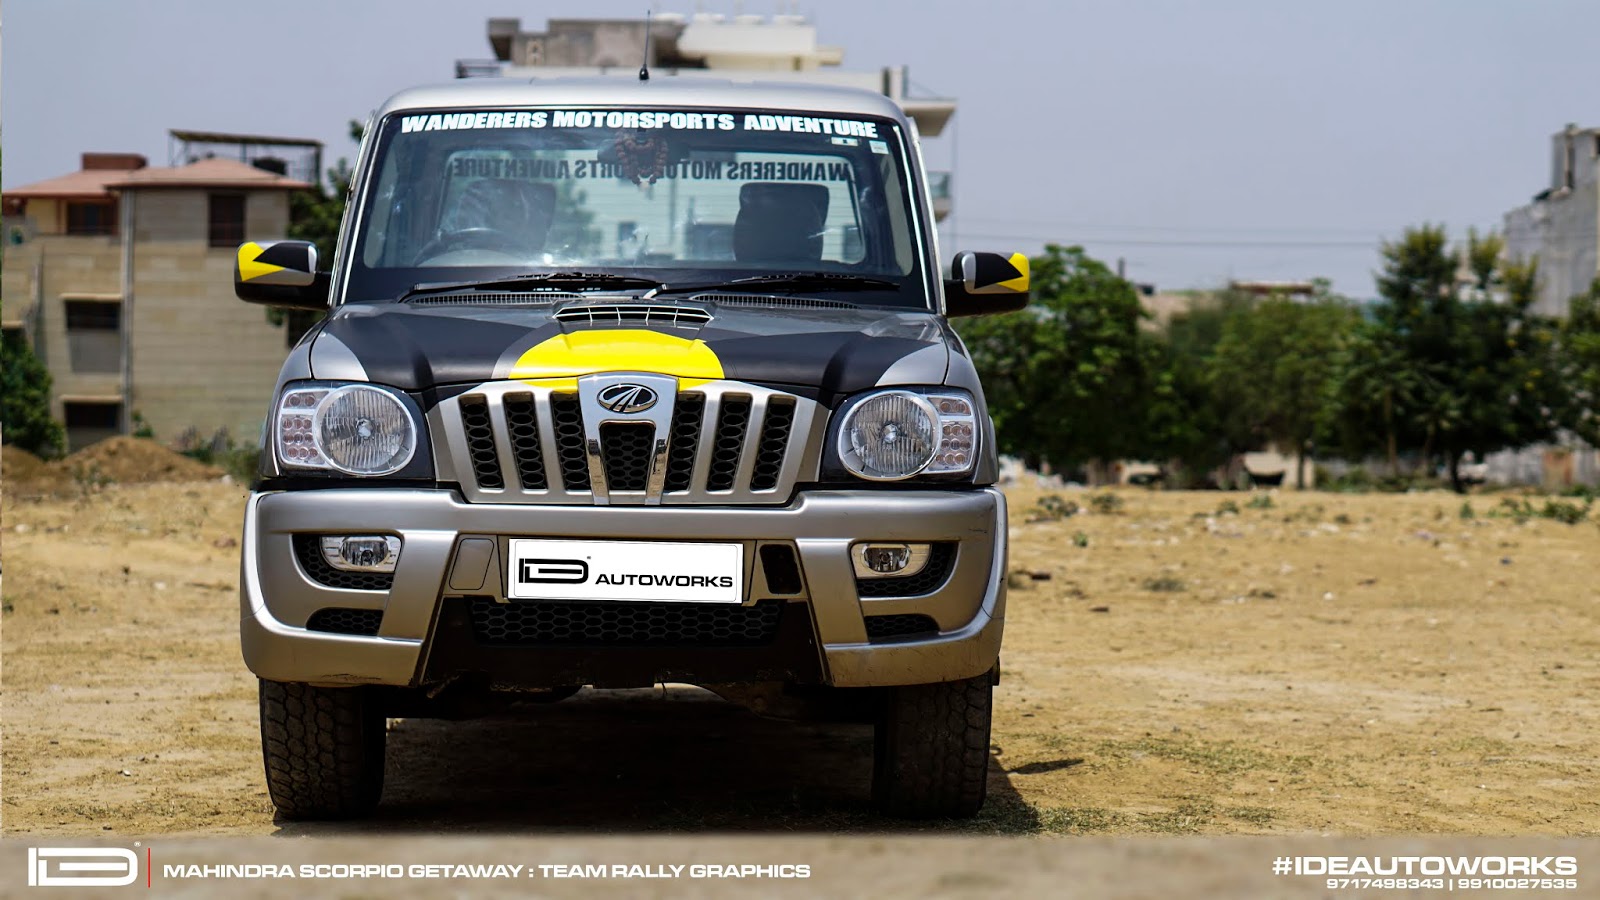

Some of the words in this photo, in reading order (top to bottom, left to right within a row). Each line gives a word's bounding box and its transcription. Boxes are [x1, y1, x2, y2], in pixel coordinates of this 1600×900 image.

[401, 111, 548, 133] WANDERERS
[552, 110, 735, 130] MOTORSPORTS
[744, 114, 879, 138] ADVENTURE
[595, 573, 733, 588] AUTOWORKS
